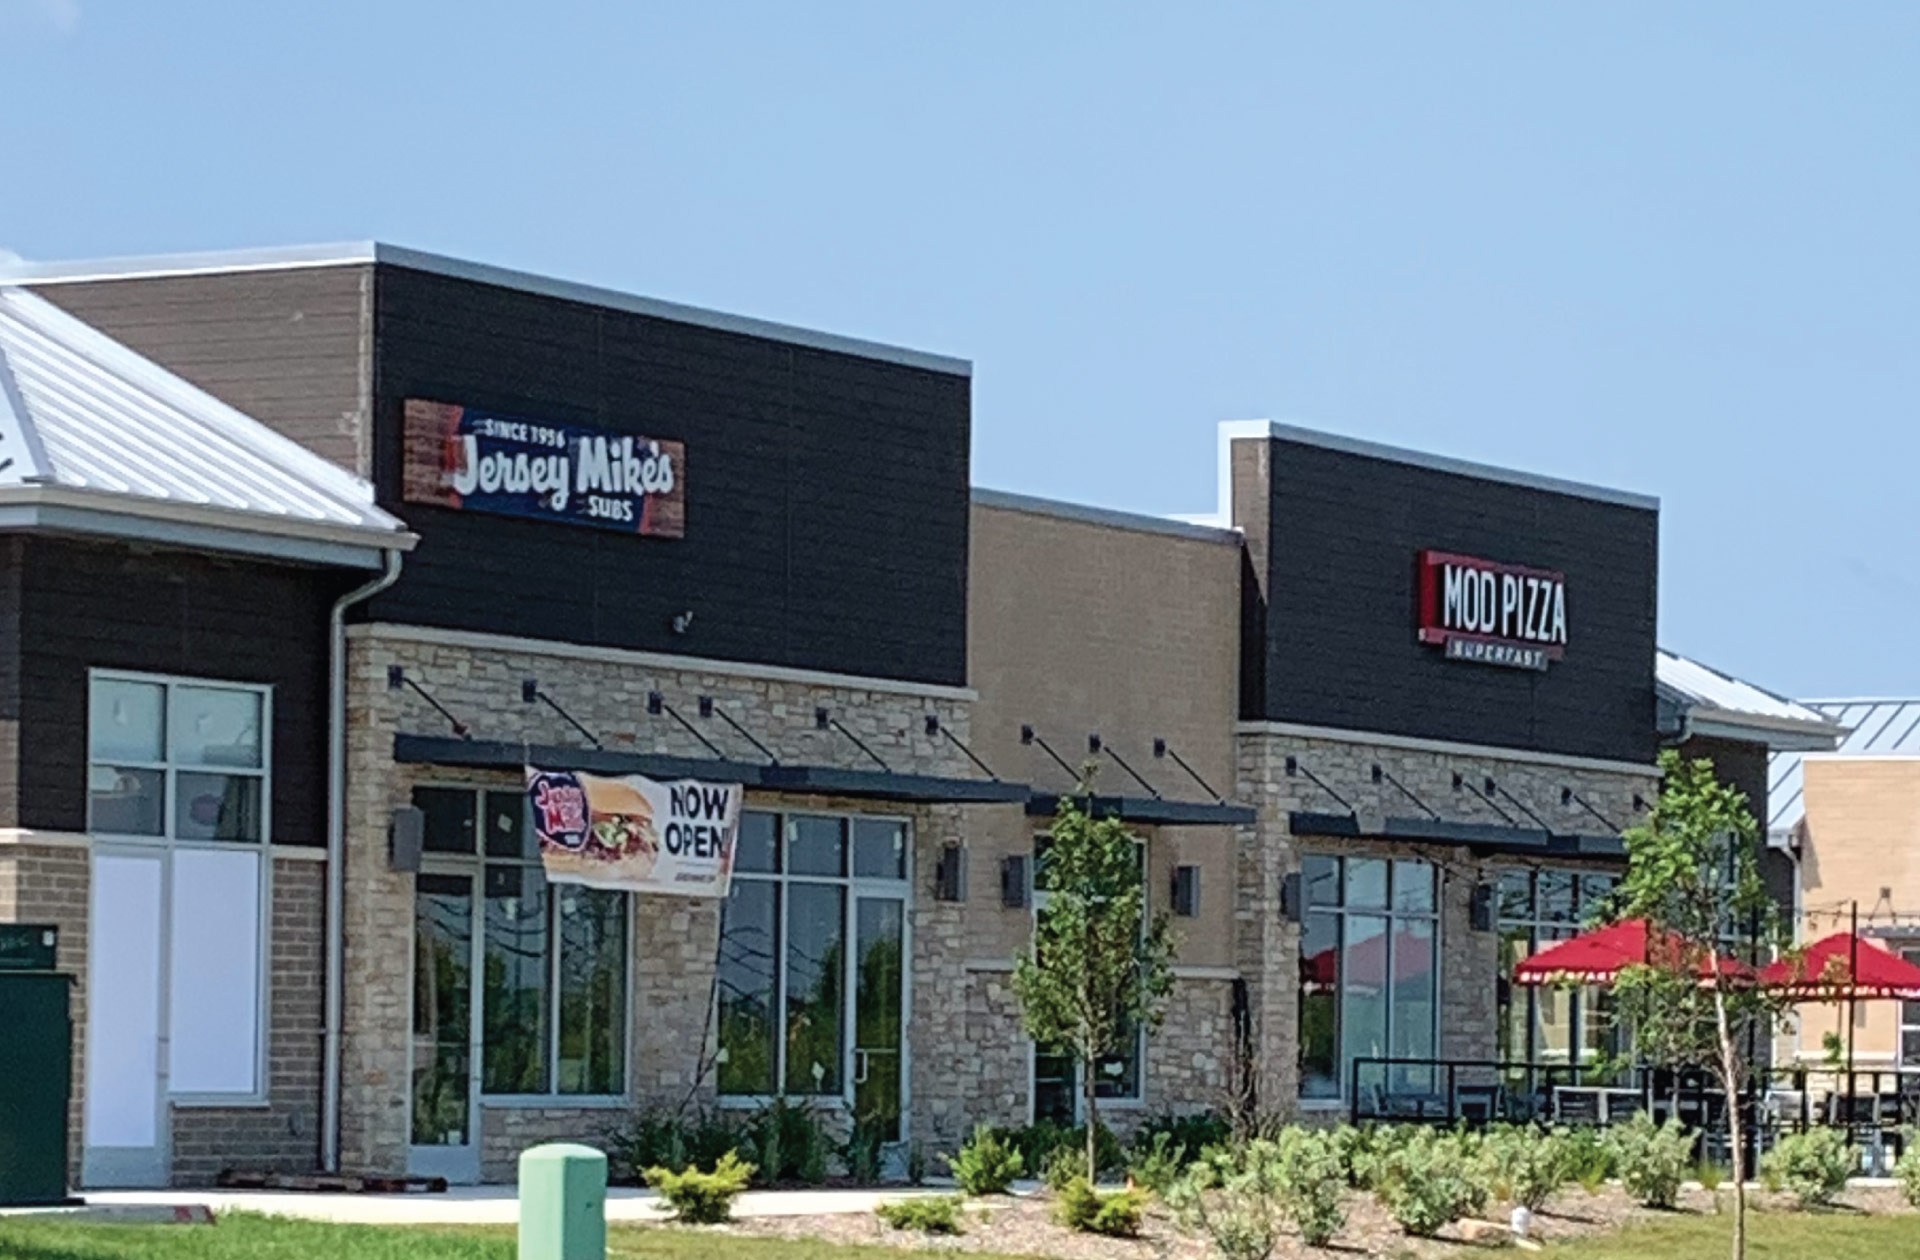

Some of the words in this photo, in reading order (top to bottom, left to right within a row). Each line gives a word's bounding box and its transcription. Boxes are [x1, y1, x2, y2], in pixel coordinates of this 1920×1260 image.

[484, 418, 528, 442] SINCE
[530, 425, 566, 449] 1956
[451, 434, 569, 511] Jersey
[577, 436, 674, 496] Mike's
[588, 495, 634, 522] SUBS
[1444, 564, 1496, 633] MOD
[1502, 573, 1568, 645] PIZZA
[1453, 640, 1543, 666] SUPERFAST
[670, 786, 729, 820] NOW
